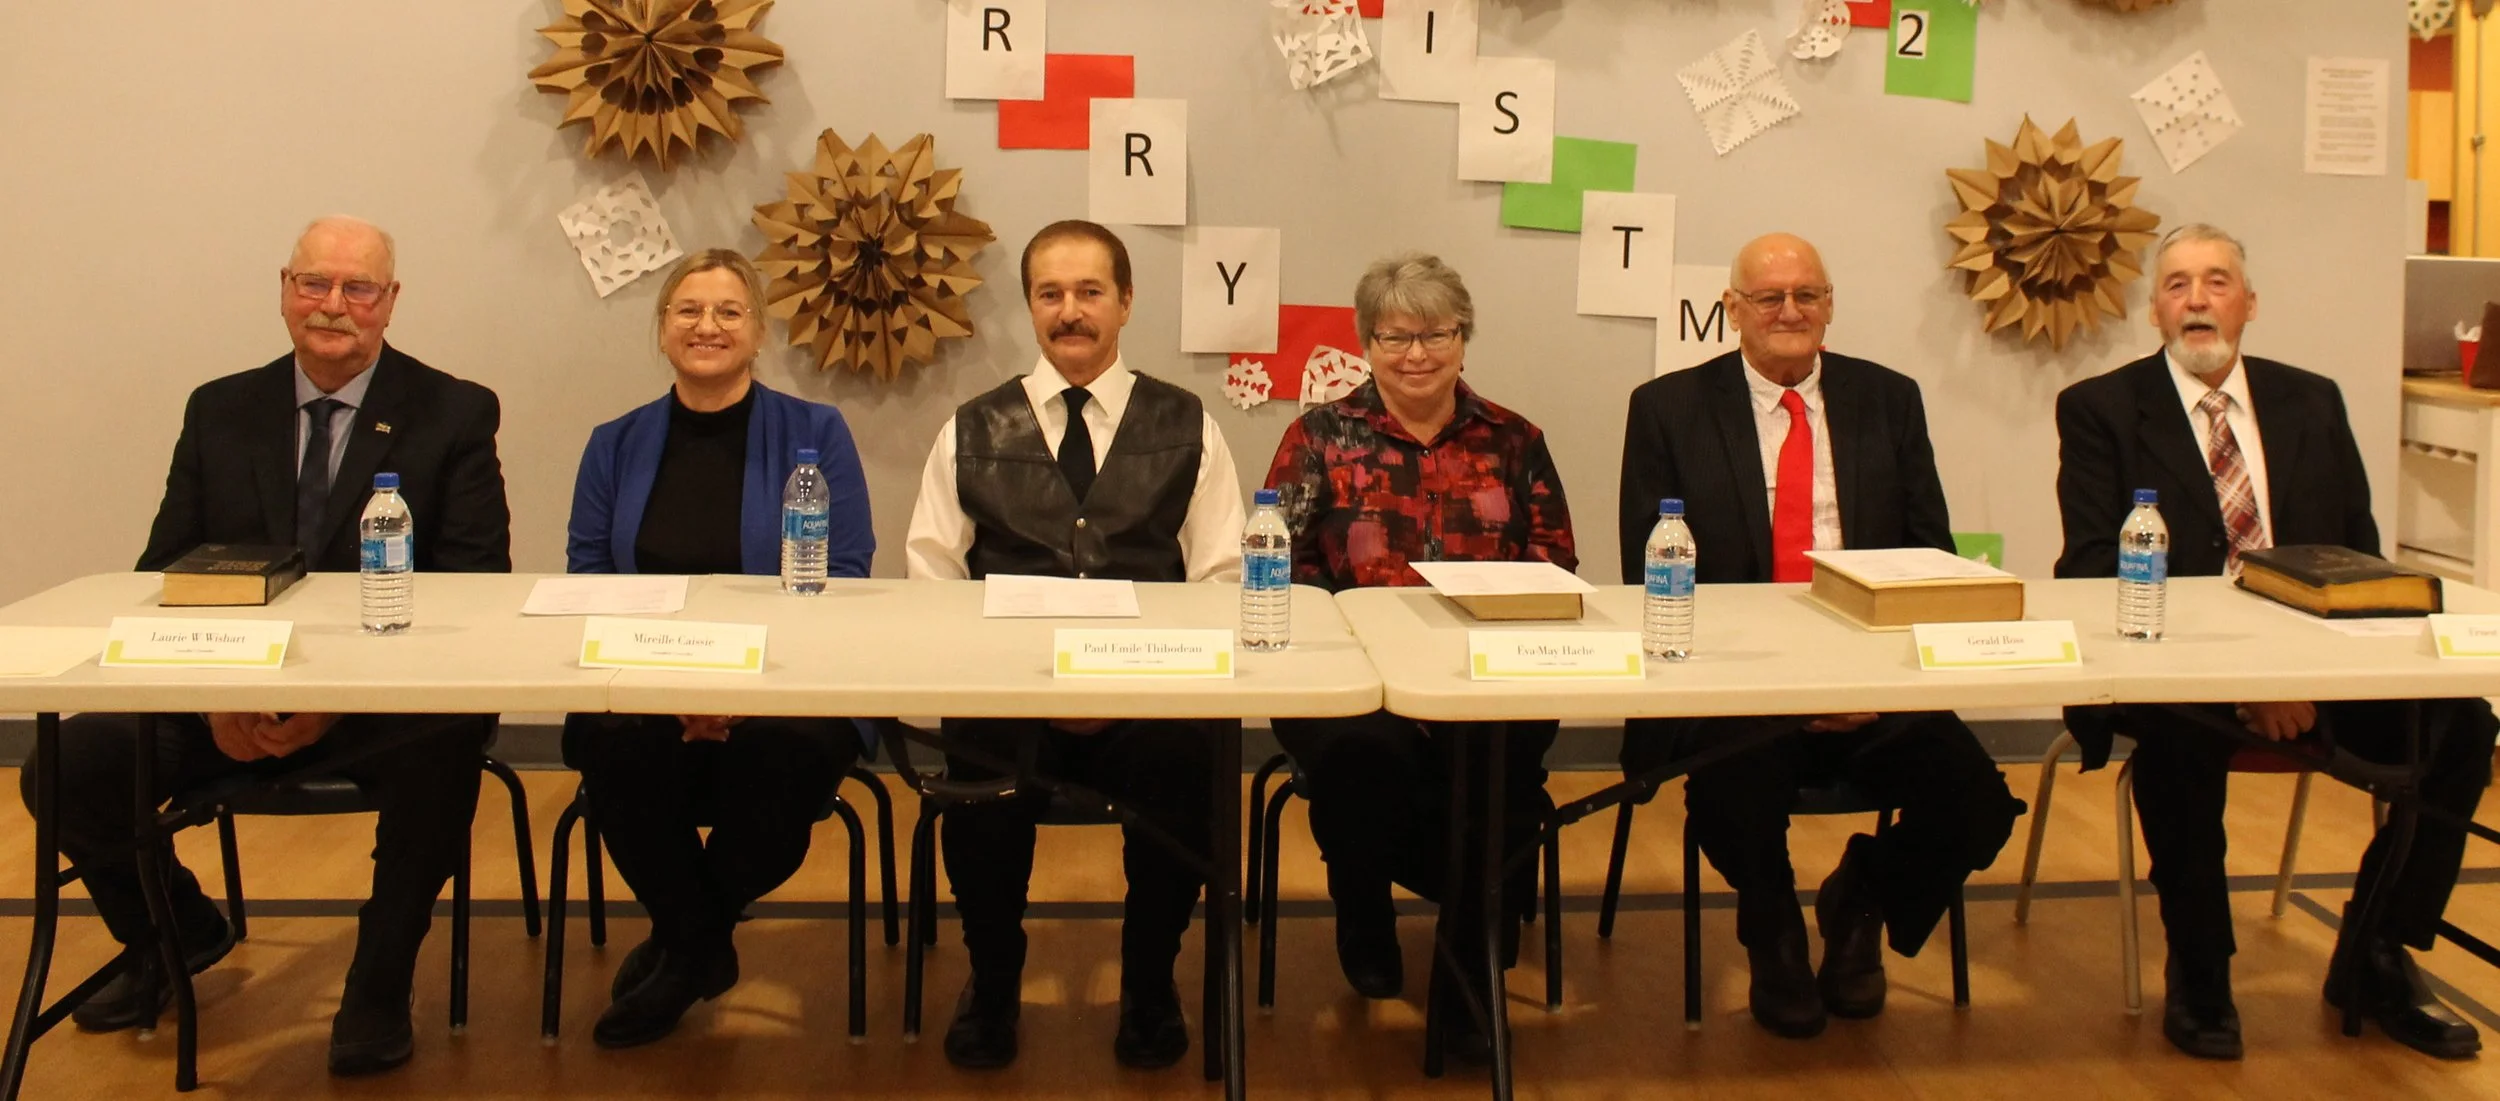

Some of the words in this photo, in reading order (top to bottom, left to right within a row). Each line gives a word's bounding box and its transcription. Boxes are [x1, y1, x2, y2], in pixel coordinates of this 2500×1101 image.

[983, 7, 1012, 52] R
[1425, 10, 1434, 54] I
[1898, 13, 1924, 57] 2
[1493, 91, 1519, 135] S
[1125, 132, 1154, 177] R
[1612, 225, 1644, 269] T
[1216, 261, 1247, 306] Y
[1679, 299, 1724, 343] M
[151, 631, 188, 643] Laurie
[191, 632, 202, 643] W
[205, 632, 246, 644] Wishart
[633, 632, 674, 645] Mireille
[677, 635, 715, 647] Caissie
[1084, 642, 1108, 653] Paul
[1144, 642, 1203, 653] Thibodeau
[1967, 636, 2000, 646] Gerald
